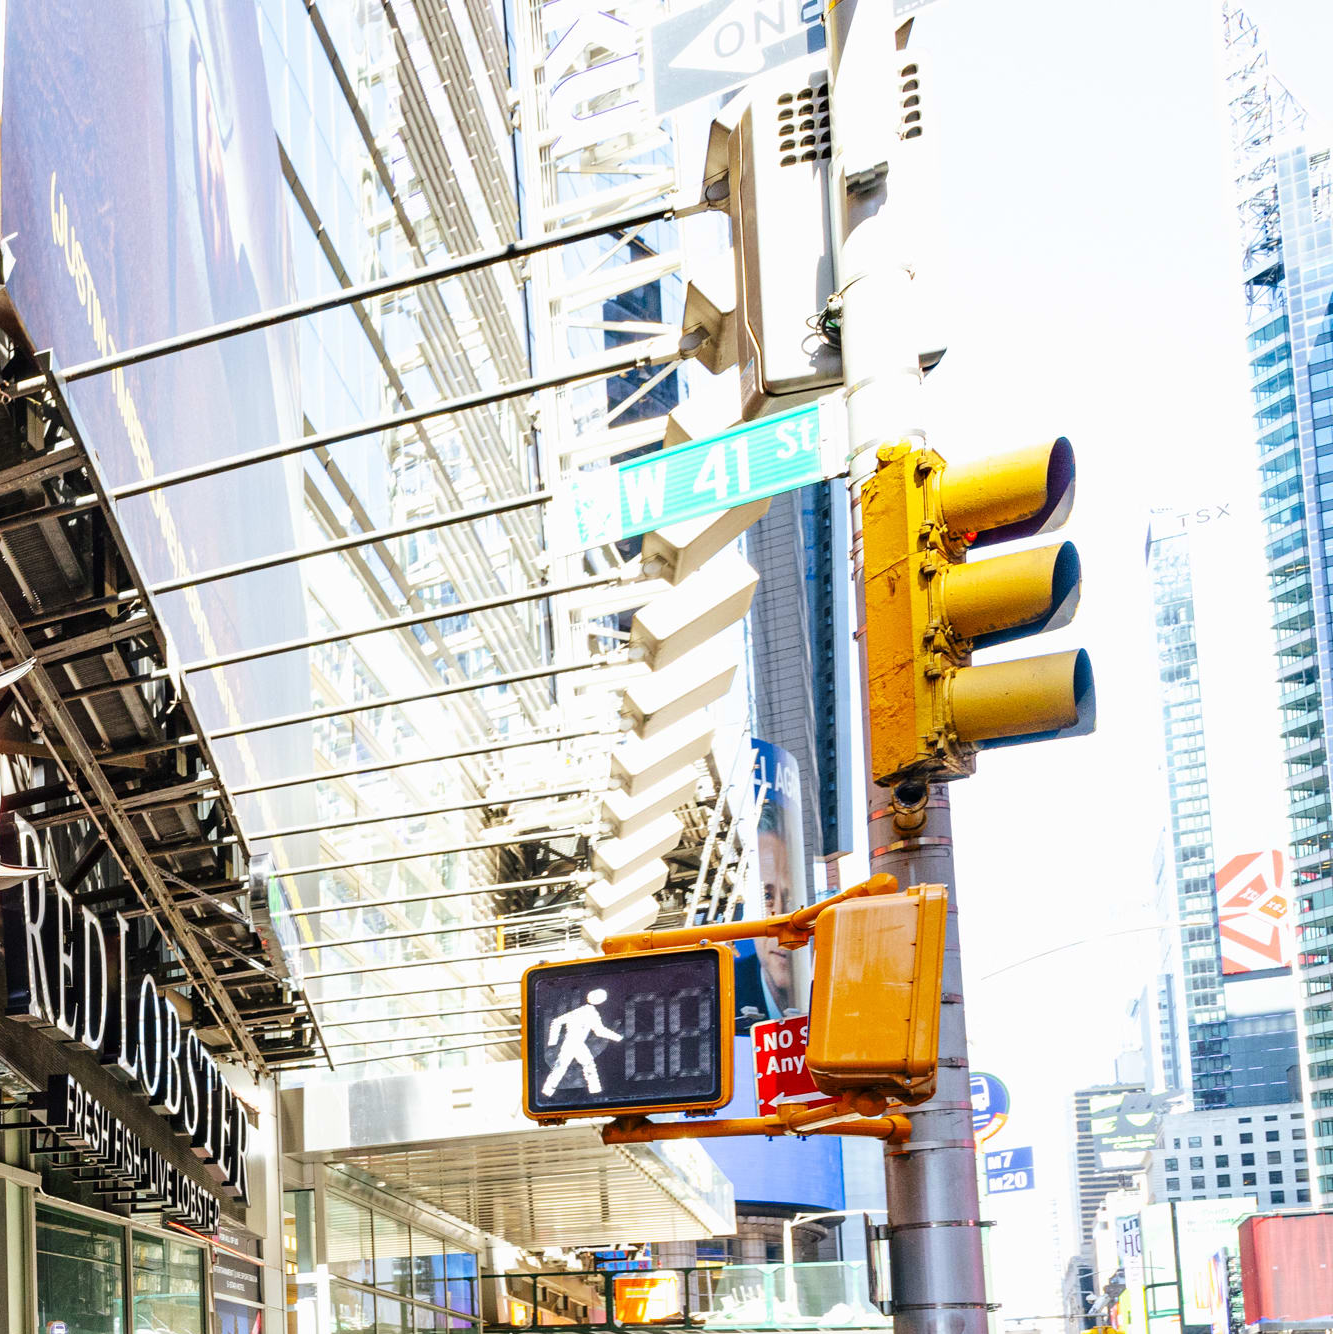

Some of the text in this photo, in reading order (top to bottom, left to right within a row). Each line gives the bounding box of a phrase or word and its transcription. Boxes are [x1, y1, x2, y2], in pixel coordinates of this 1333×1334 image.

[622, 417, 815, 524] W 41 St
[14, 811, 251, 1208] RED LOBSTER
[763, 1029, 794, 1052] NO
[66, 1072, 221, 1234] FRESH FISH LIVE LOBSTER
[987, 1151, 1014, 1170] M7
[988, 1171, 1028, 1192] M20
